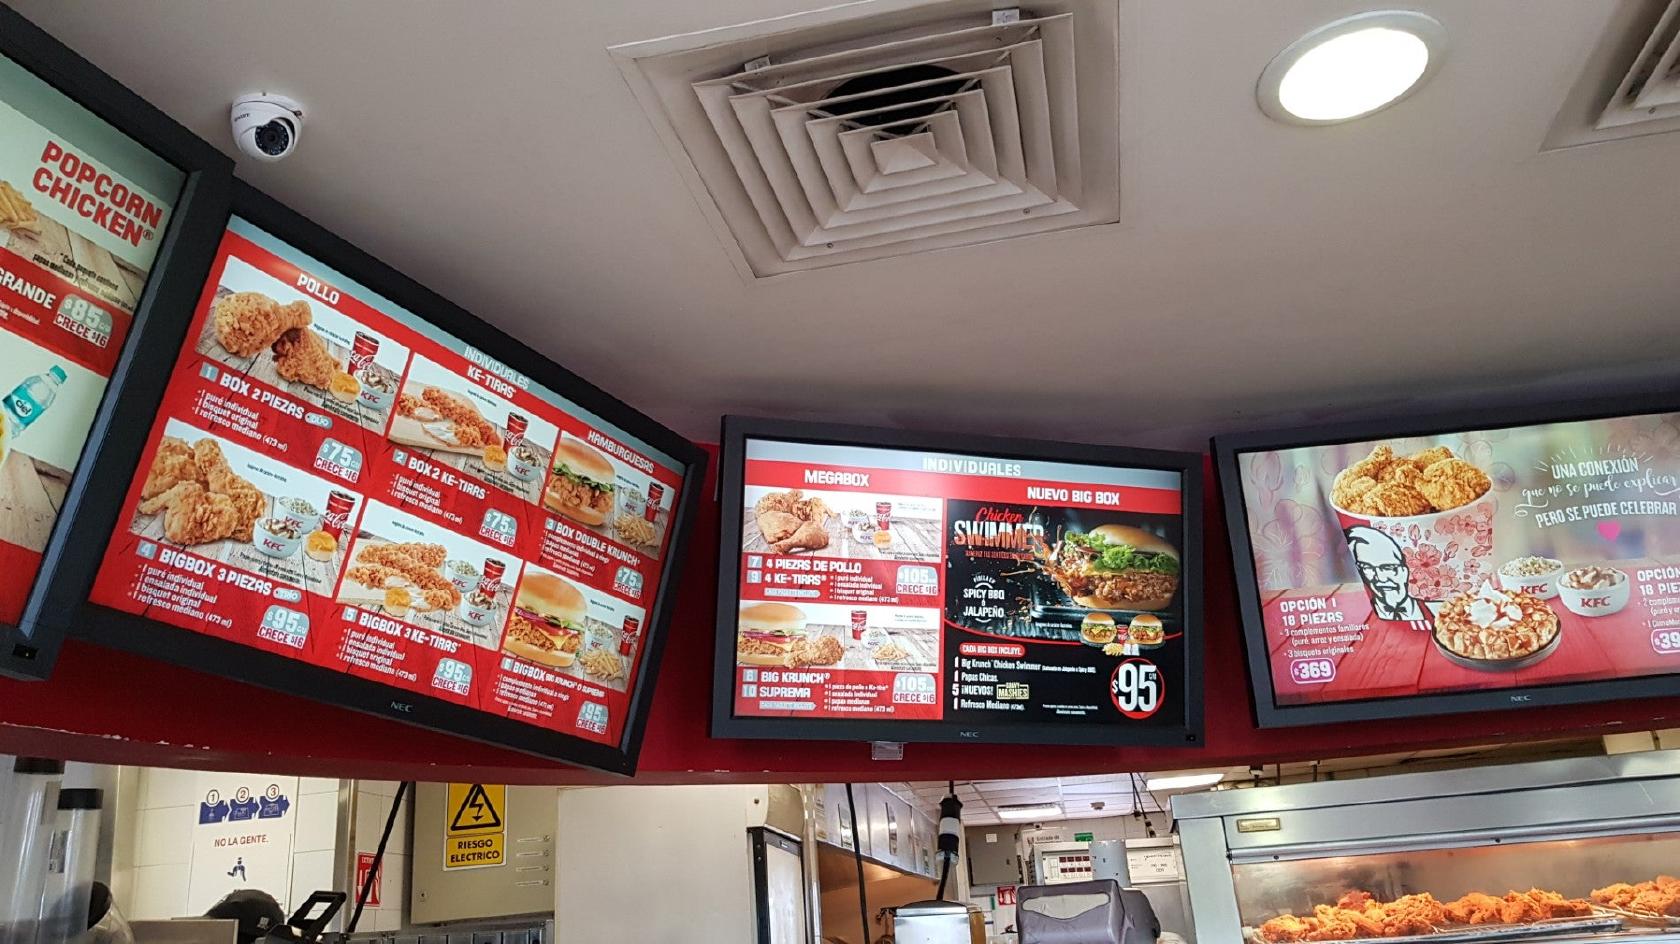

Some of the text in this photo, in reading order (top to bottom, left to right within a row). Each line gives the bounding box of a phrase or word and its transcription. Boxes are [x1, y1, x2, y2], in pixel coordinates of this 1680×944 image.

[40, 140, 162, 229] POPCORN
[297, 273, 339, 305] POLLO
[55, 313, 90, 338] CRECE
[91, 331, 107, 348] $16
[465, 346, 530, 390] INDIVIDUALES
[220, 372, 251, 396] BOX
[251, 388, 262, 400] 2
[261, 392, 305, 419] PIEZAS
[361, 390, 381, 404] KFC
[206, 393, 259, 420] puré individual
[202, 399, 259, 430] bisquet original
[199, 407, 262, 440] refresco mediano
[588, 431, 654, 473] HAMBURGUESAS
[316, 458, 357, 481] CRECE $16
[408, 458, 440, 479] BOX 2
[515, 465, 530, 475] KFC
[922, 457, 1022, 477] INDIVIDUALES
[1551, 455, 1639, 479] UNA CONEXIÓN
[413, 481, 441, 497] individual
[804, 470, 1120, 505] MEGABOX NUEVO BIG BOX
[1522, 468, 1677, 506] que no se puede explicar
[394, 490, 443, 516] refresco mediano
[419, 490, 441, 506] original
[976, 507, 1024, 522] Chicken
[1535, 501, 1677, 528] PERO SE PUEDE CELEBRAR
[481, 526, 502, 542] CRECE
[556, 522, 607, 553] BOX DOUBLE
[264, 538, 285, 551] KFC
[160, 548, 217, 577] BIGBOX
[217, 569, 226, 581] 3
[226, 571, 273, 596] PIEZAS
[766, 559, 862, 573] 4 PIEZAS DE POLLO
[147, 566, 205, 590] puré individual
[765, 574, 771, 582] 4
[141, 585, 201, 608] bisquet original
[144, 576, 217, 603] ensalada individual
[897, 584, 936, 594] CRECE $16
[964, 589, 1005, 600] SPICY BBQ
[1520, 584, 1547, 594] KFC
[1640, 584, 1653, 595] 18
[137, 594, 204, 619] refresco mediano
[1280, 597, 1326, 613] OPCIÓN
[1581, 596, 1610, 608] KFC
[468, 610, 485, 622] KFC
[963, 606, 1004, 618] JALAPEÑO
[1282, 612, 1344, 626] 18 PIEZAS
[359, 612, 404, 637] BIGBOX
[404, 628, 411, 638] 3
[1291, 627, 1336, 636] complementos
[1338, 624, 1369, 632] familiares
[258, 626, 304, 646] CRECE $16
[365, 635, 395, 648] individual
[1333, 632, 1363, 643] ensalada)
[346, 646, 392, 665] bisquet original
[376, 646, 405, 661] individual
[1294, 649, 1321, 658] bisquets
[1323, 646, 1354, 656] originales
[343, 654, 395, 675] refresco mediano
[954, 656, 958, 668] 1
[961, 659, 971, 669] Big
[993, 660, 1015, 669] Chicken
[1016, 661, 1041, 671] Swimmer
[1294, 661, 1331, 678] $369
[513, 662, 546, 681] BIGBOX
[761, 672, 780, 683] BIG
[954, 670, 958, 682] 1
[961, 672, 978, 682] Papas
[432, 676, 457, 690] CRECE
[952, 683, 994, 696] 5 ¡NUEVOS!
[1111, 664, 1157, 712] $95
[760, 687, 810, 697] SUPREMA
[894, 693, 935, 703] CRECE $16
[998, 688, 1028, 698] MASHIES
[391, 701, 414, 712] NEC
[954, 697, 1009, 710] 1 Refresco Mediano
[577, 719, 596, 730] CRECE
[211, 794, 214, 802] 1
[270, 788, 276, 796] 3
[214, 839, 226, 847] NO
[228, 837, 238, 846] LA
[457, 839, 493, 849] RIESGO
[450, 851, 500, 863] ELECTRICO
